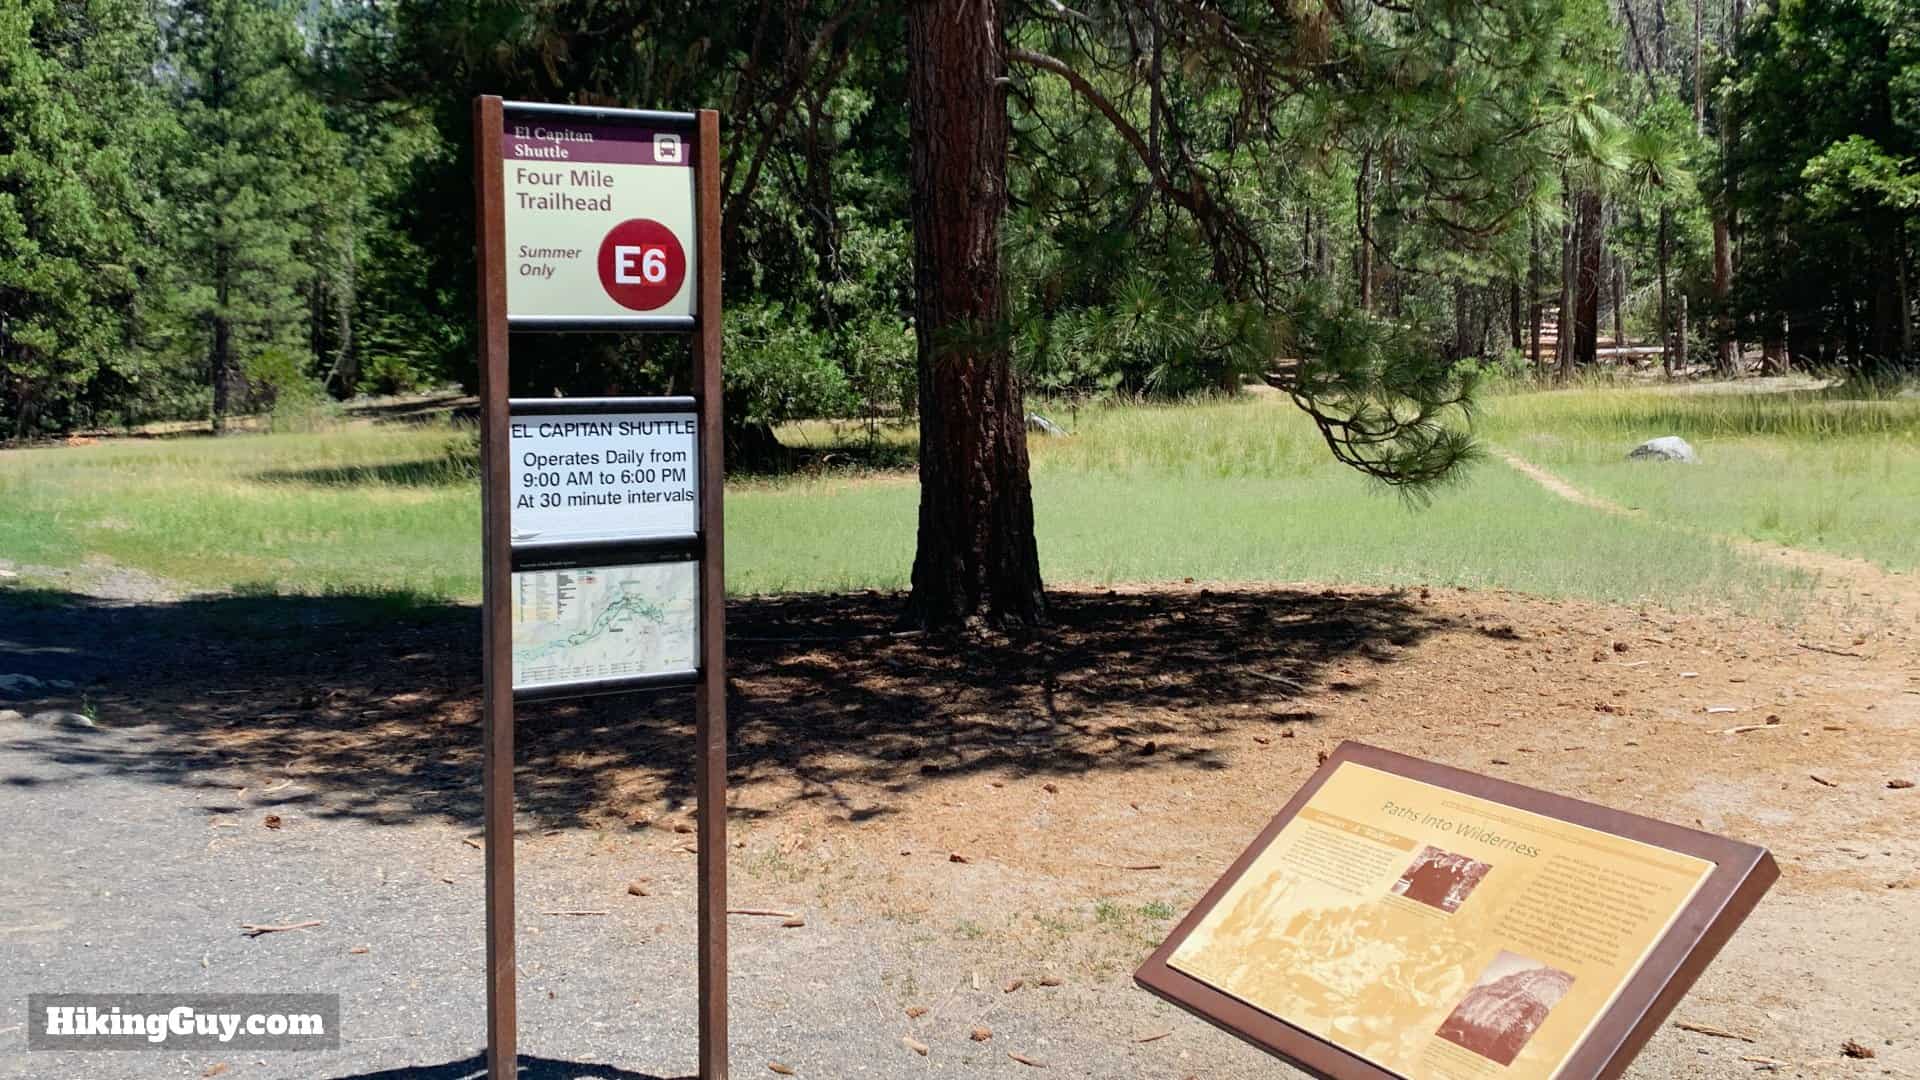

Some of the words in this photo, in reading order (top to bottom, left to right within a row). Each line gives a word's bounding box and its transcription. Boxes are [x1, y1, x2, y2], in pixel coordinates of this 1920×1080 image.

[514, 126, 531, 139] El
[534, 127, 594, 144] Capitan
[514, 144, 569, 159] Shuttle
[516, 168, 563, 186] Four
[570, 170, 614, 188] Mile
[516, 192, 612, 212] Trailhead
[519, 245, 582, 260] Summer
[519, 263, 555, 280] Only
[615, 245, 667, 285] E6
[512, 423, 533, 438] EL
[539, 421, 612, 438] CAPITAN
[619, 420, 696, 436] SHUTTLE
[523, 452, 600, 470] Operates
[606, 449, 645, 466] Daily
[650, 449, 687, 463] from
[523, 472, 560, 488] 9:00
[566, 471, 593, 486] AM
[599, 470, 615, 485] to
[620, 468, 656, 484] 6:00
[661, 468, 686, 482] PM
[516, 493, 535, 509] At
[539, 492, 561, 508] 30
[567, 490, 622, 507] minute
[627, 488, 695, 504] intervals
[1381, 800, 1418, 822] Paths
[1455, 823, 1541, 858] Wilderness
